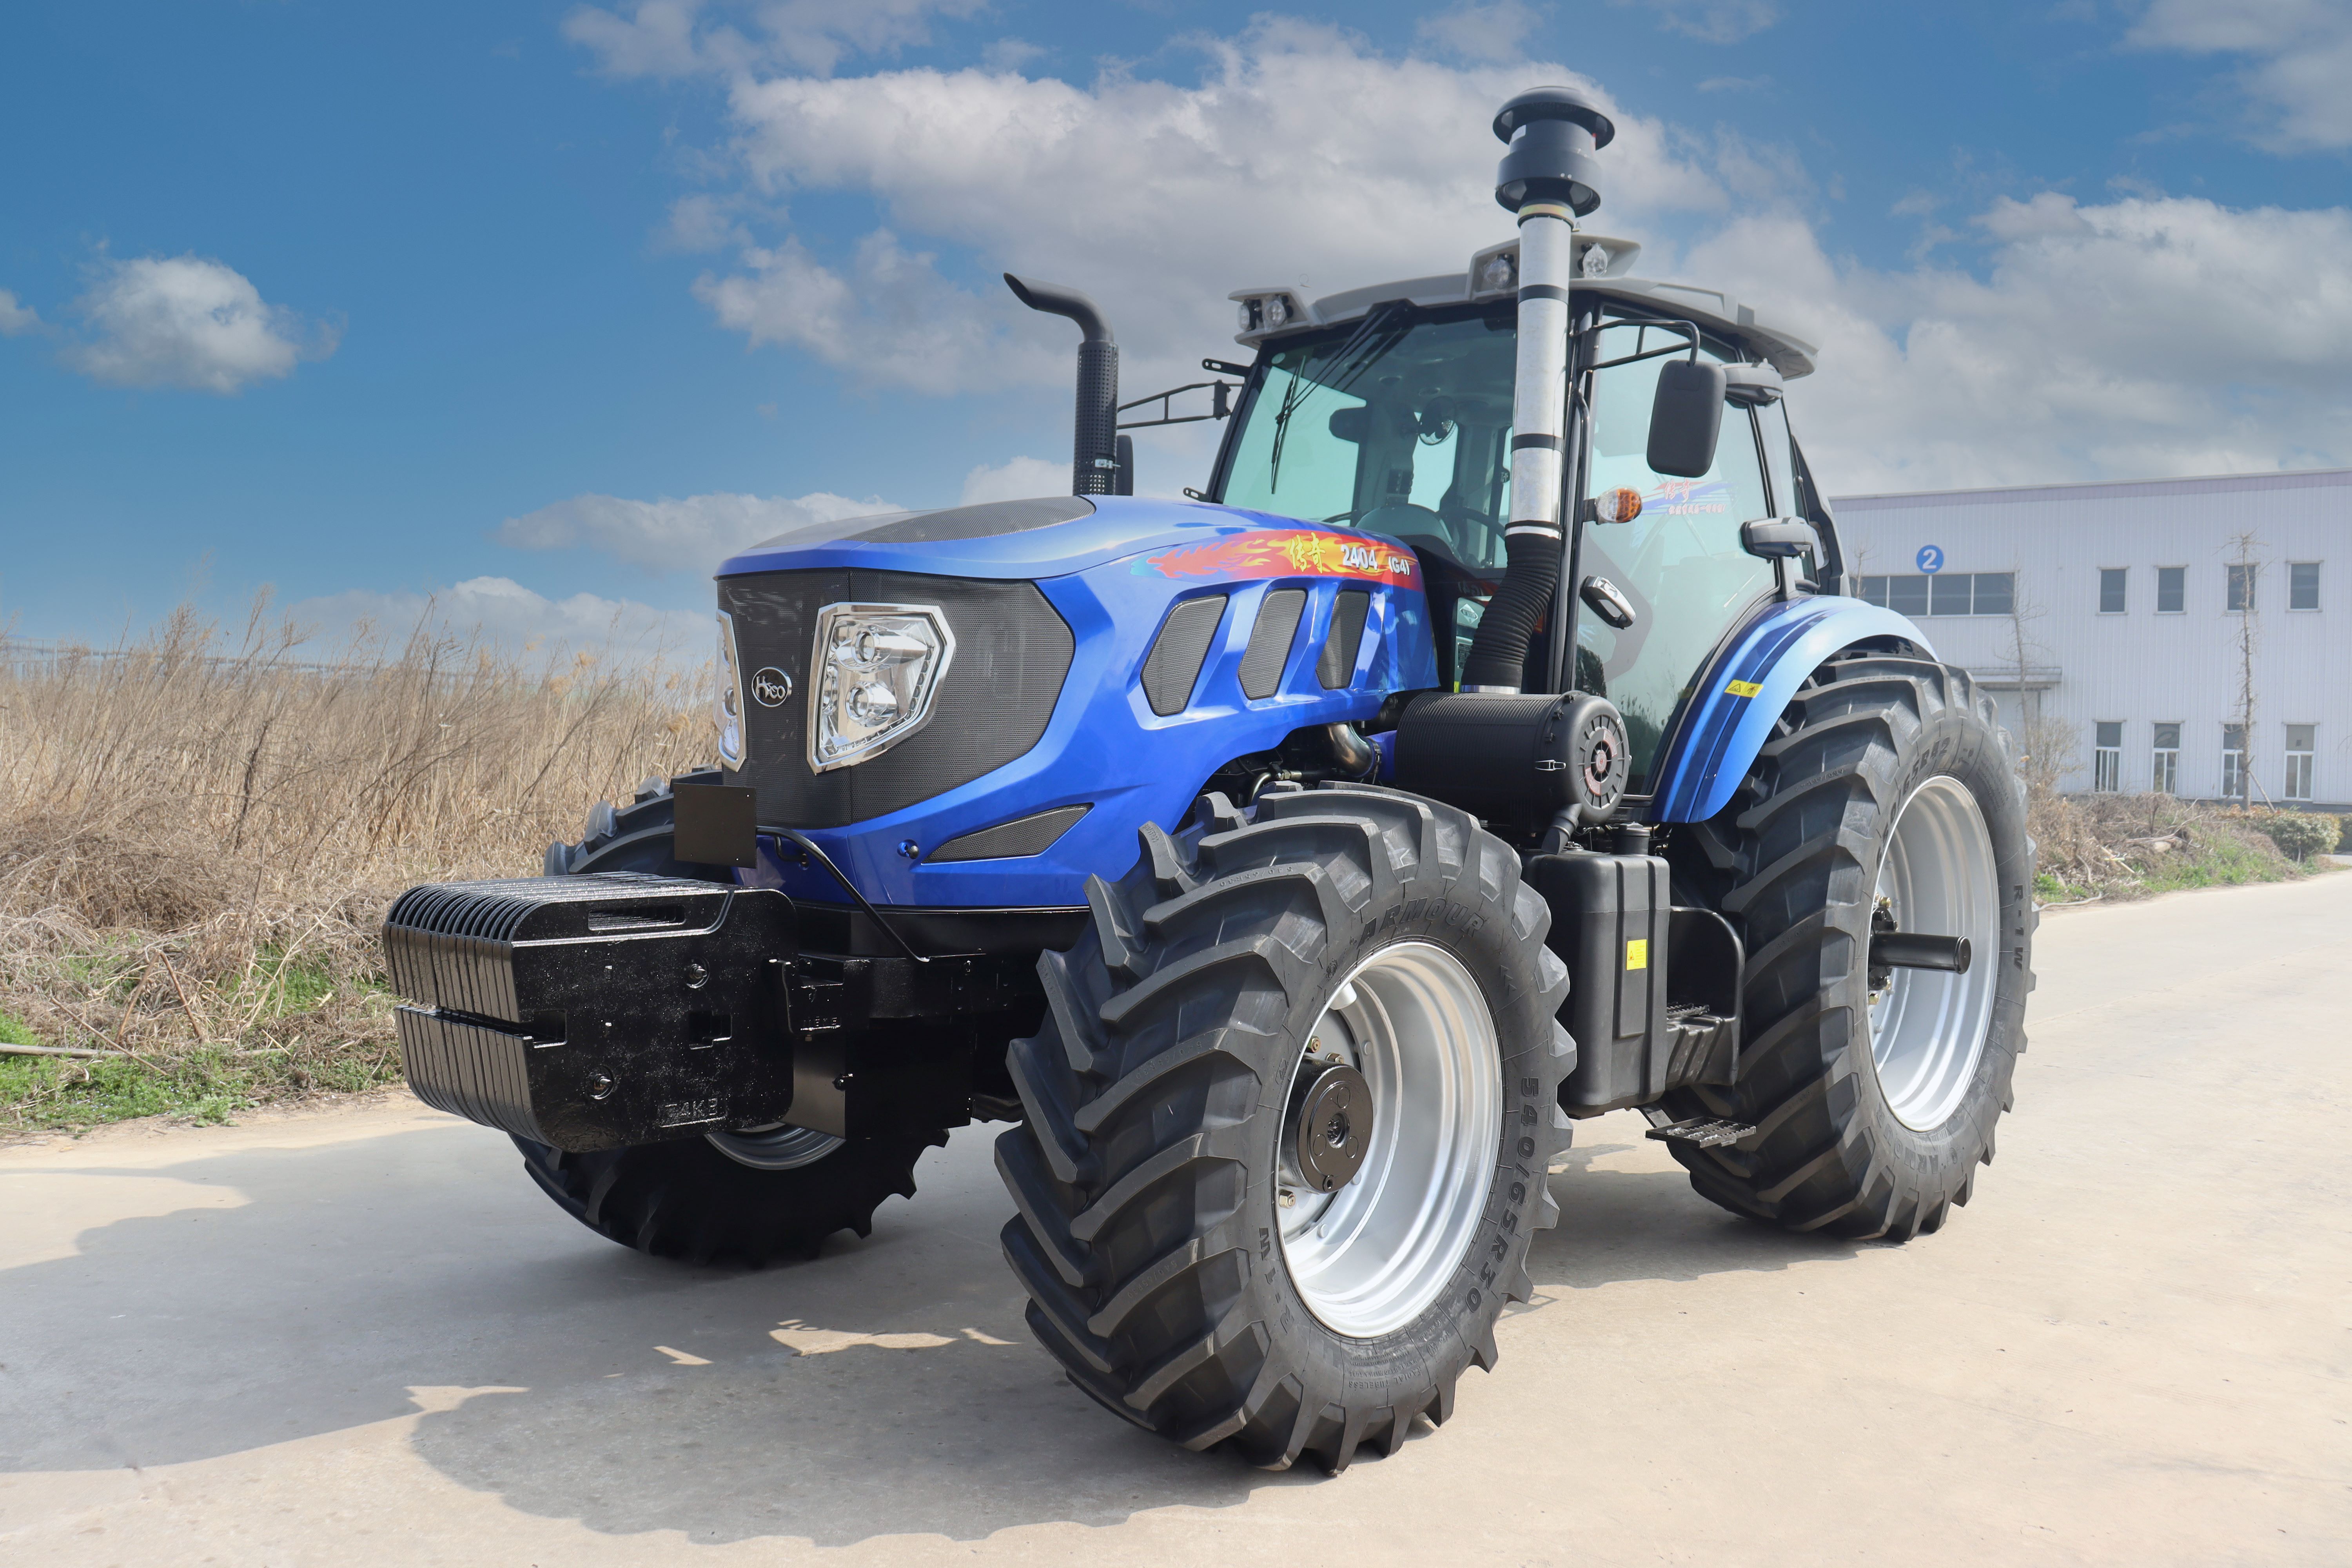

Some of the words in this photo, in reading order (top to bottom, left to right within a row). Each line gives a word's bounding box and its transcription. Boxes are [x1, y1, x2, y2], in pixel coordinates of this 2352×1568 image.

[1289, 532, 1326, 573] 传奇
[1341, 544, 1377, 570] 2404
[1388, 556, 1410, 575] (G4)
[1922, 549, 1937, 569] 2
[1356, 897, 1485, 949] ARMOUR
[1465, 1077, 1539, 1313] 540/65R30
[1348, 1379, 1389, 1389] TUBELESS
[1393, 1366, 1422, 1385] RADIAL
